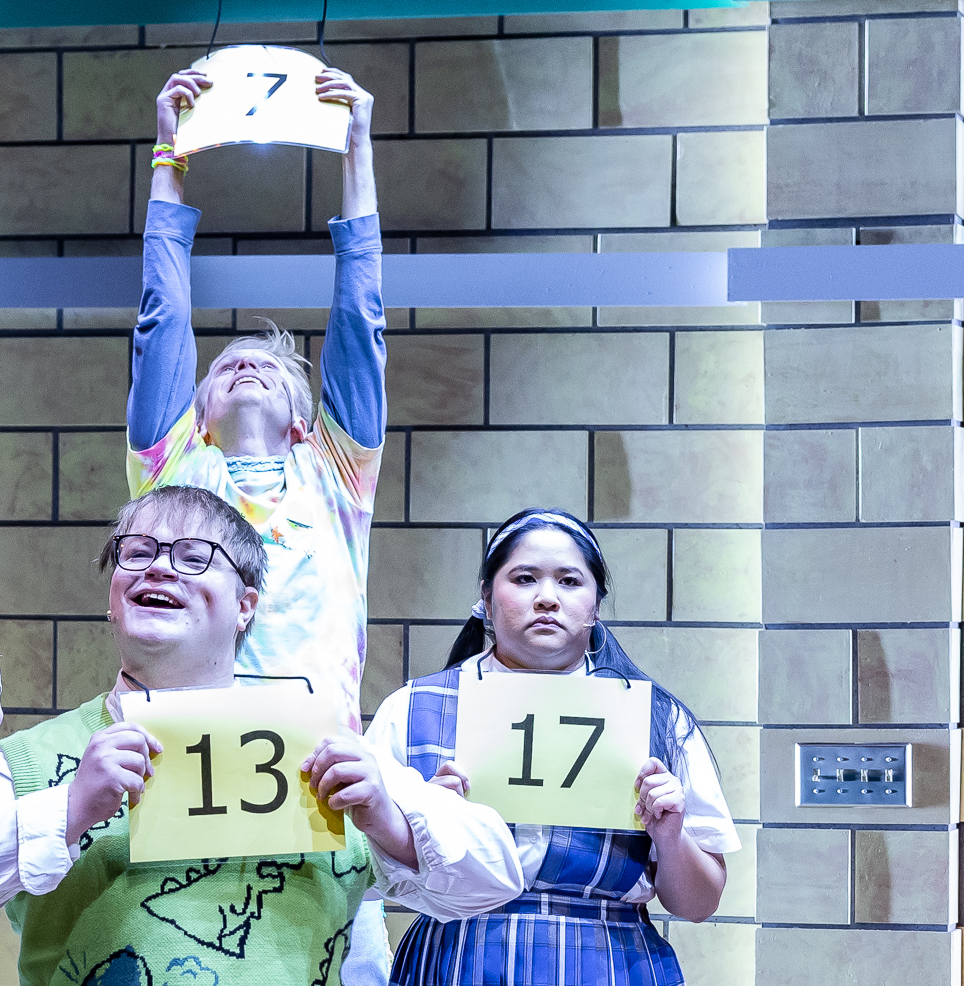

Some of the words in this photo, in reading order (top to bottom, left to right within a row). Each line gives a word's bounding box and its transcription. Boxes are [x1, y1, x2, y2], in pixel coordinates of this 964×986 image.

[246, 72, 287, 116] 7
[186, 730, 288, 816] 13
[508, 714, 605, 788] 17
